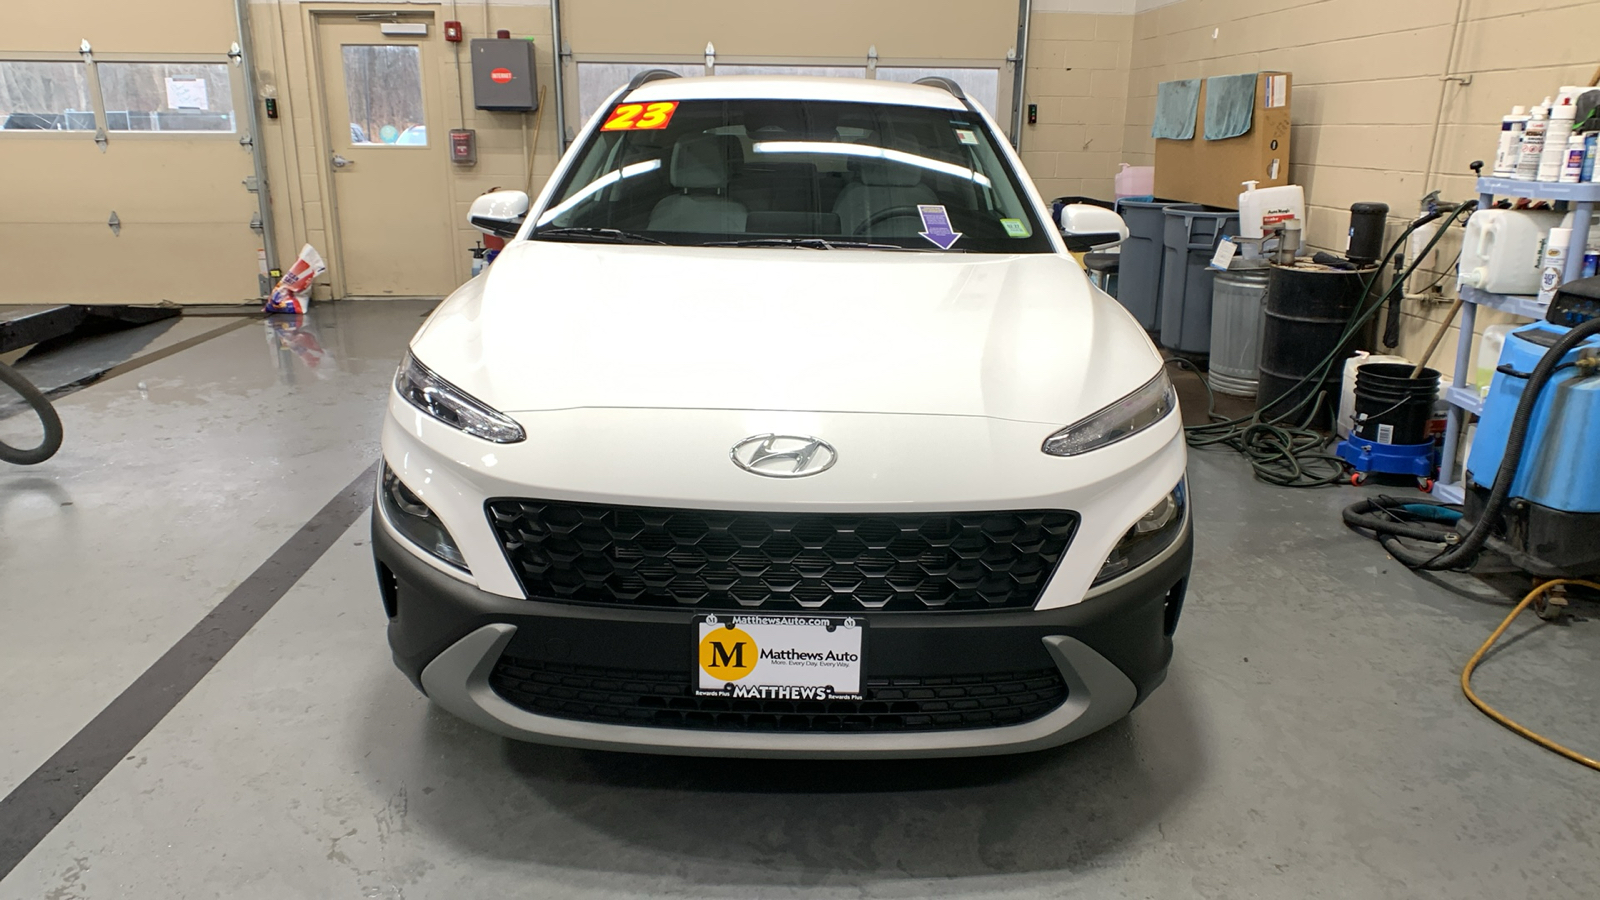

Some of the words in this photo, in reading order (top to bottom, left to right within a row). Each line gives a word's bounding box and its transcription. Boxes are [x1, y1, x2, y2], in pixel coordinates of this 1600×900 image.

[604, 102, 674, 130] 23
[732, 616, 830, 626] MatthewsAuto.com
[708, 641, 747, 668] M
[760, 648, 824, 661] Matthews
[825, 650, 858, 662] Auto
[733, 685, 826, 701] MATTHEWS
